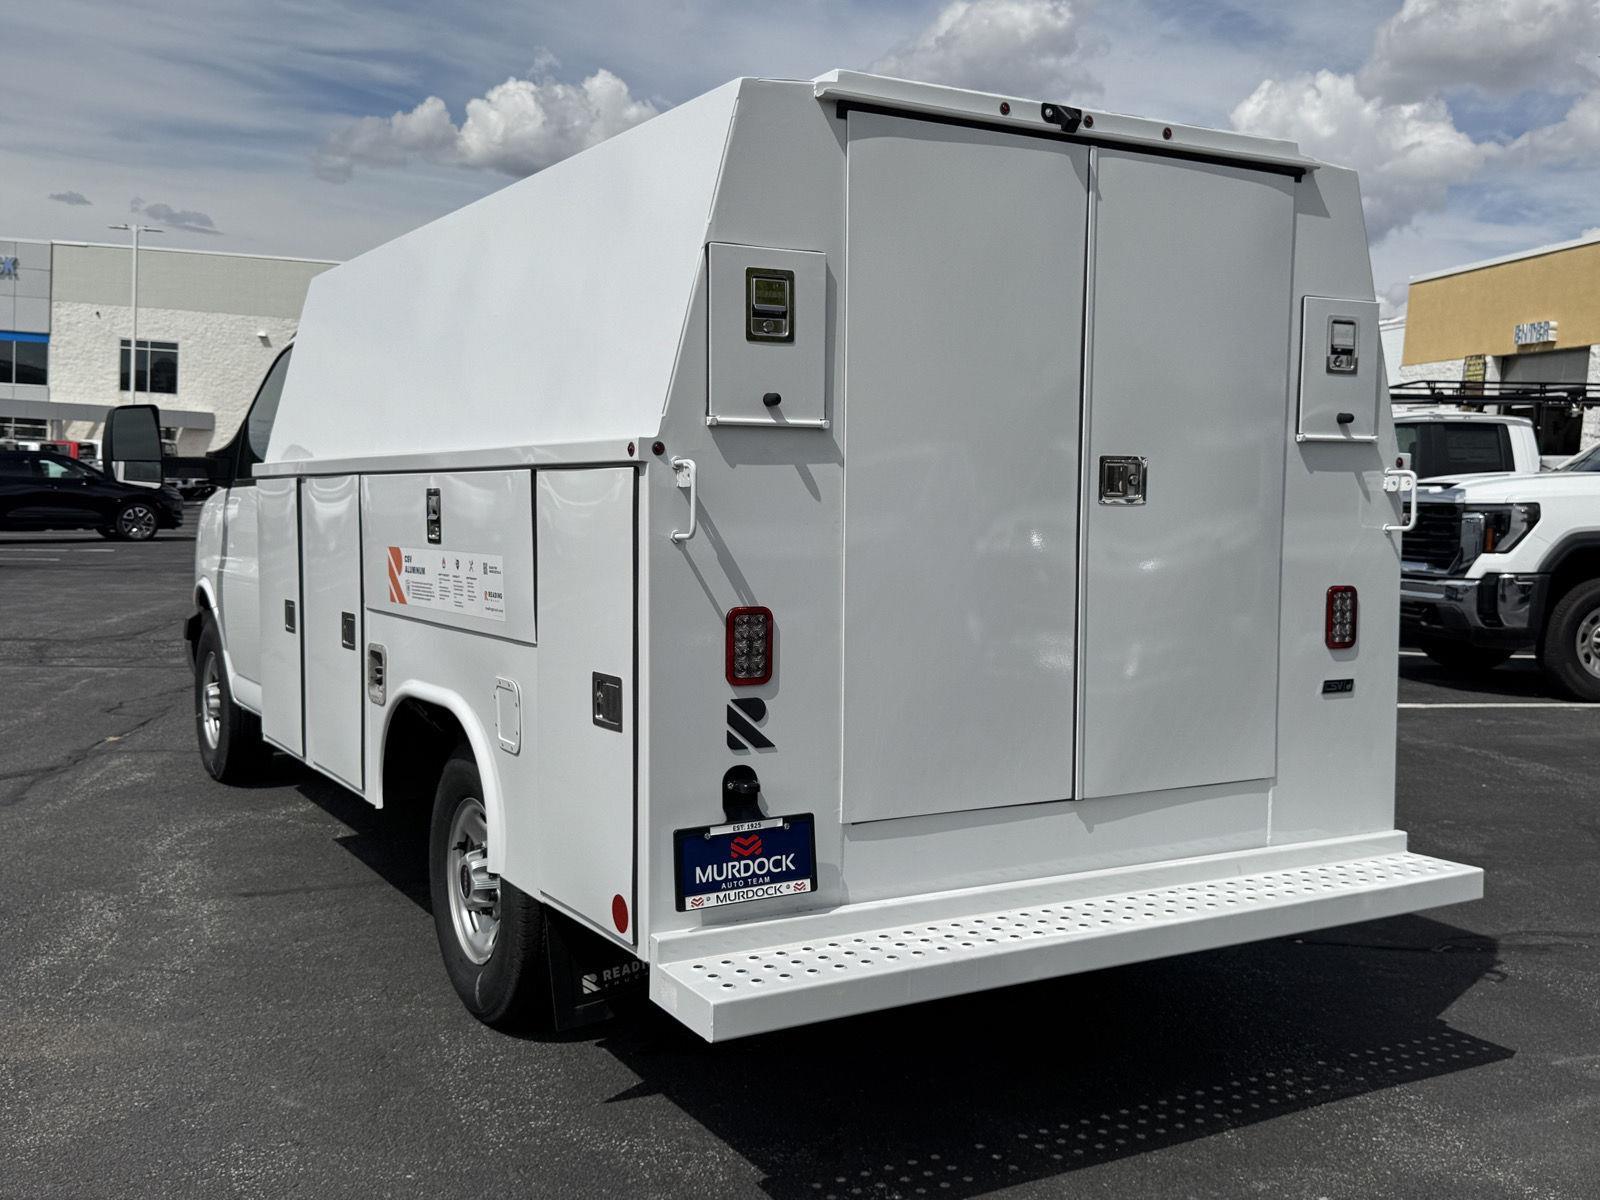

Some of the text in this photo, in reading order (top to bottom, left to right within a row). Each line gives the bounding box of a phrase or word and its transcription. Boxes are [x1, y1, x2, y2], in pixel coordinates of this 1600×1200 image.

[732, 821, 762, 832] EST. 1925
[695, 853, 796, 884] MURDOCK
[721, 876, 771, 890] AUTO TEAM
[716, 884, 783, 904] MURDOCK
[603, 961, 649, 981] READI
